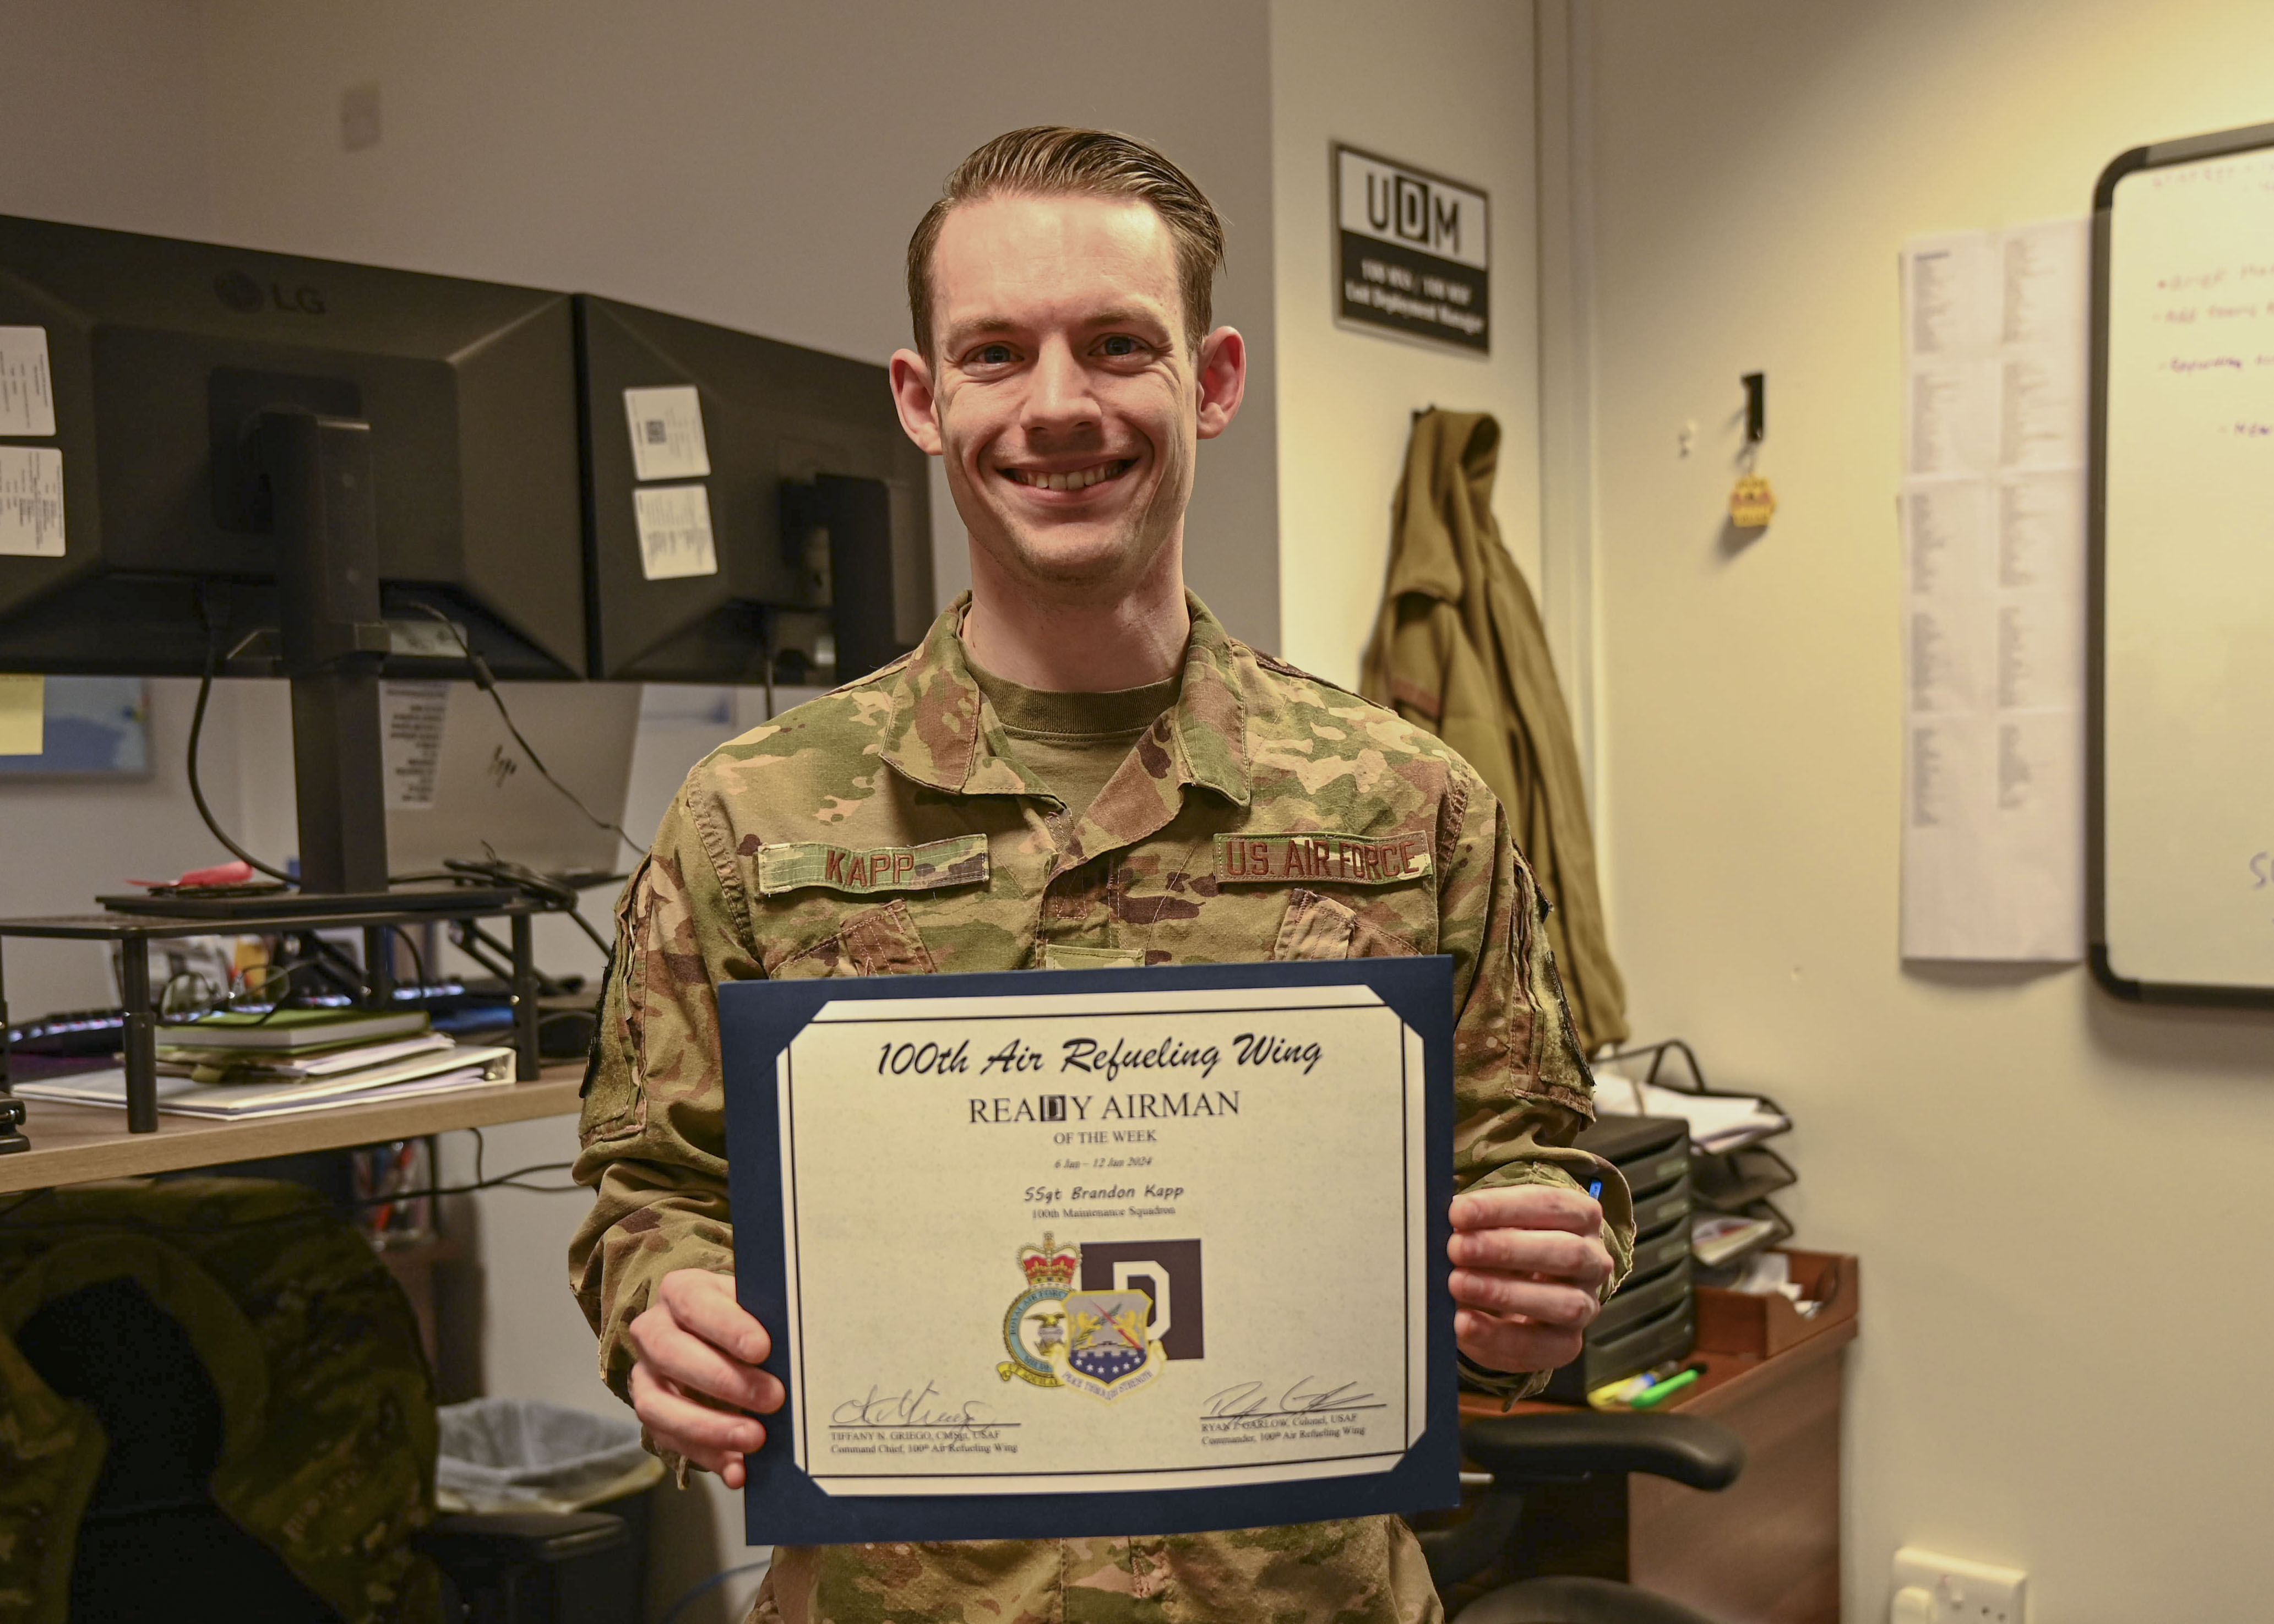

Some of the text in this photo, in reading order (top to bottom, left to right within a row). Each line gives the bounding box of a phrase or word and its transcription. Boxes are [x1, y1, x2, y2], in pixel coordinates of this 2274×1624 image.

[1367, 172, 1460, 255] UDM
[272, 282, 326, 314] LG
[825, 850, 915, 887] KAPP
[1283, 840, 1332, 876] AIR
[1338, 840, 1421, 880] FORCE
[878, 1032, 1324, 1082] 100th Air Refueling Wing
[969, 1089, 1241, 1123] READY AIRMAN
[1053, 1129, 1157, 1145] OF THE WEEK
[1127, 1156, 1153, 1167] 2024
[1024, 1184, 1184, 1203] SSgt Brandon Kapp
[1032, 1206, 1176, 1219] 100th Maintenance Squadron
[1330, 1413, 1357, 1424] USAF
[830, 1431, 874, 1441] TIFFANY
[972, 1430, 1001, 1441] USAF
[1283, 1430, 1296, 1440] Air
[1299, 1427, 1340, 1440] Refueling
[1342, 1425, 1366, 1436] Wing
[830, 1443, 876, 1454] Command
[932, 1443, 948, 1452] Air
[948, 1443, 991, 1454] Refueling
[994, 1442, 1018, 1453] Wing
